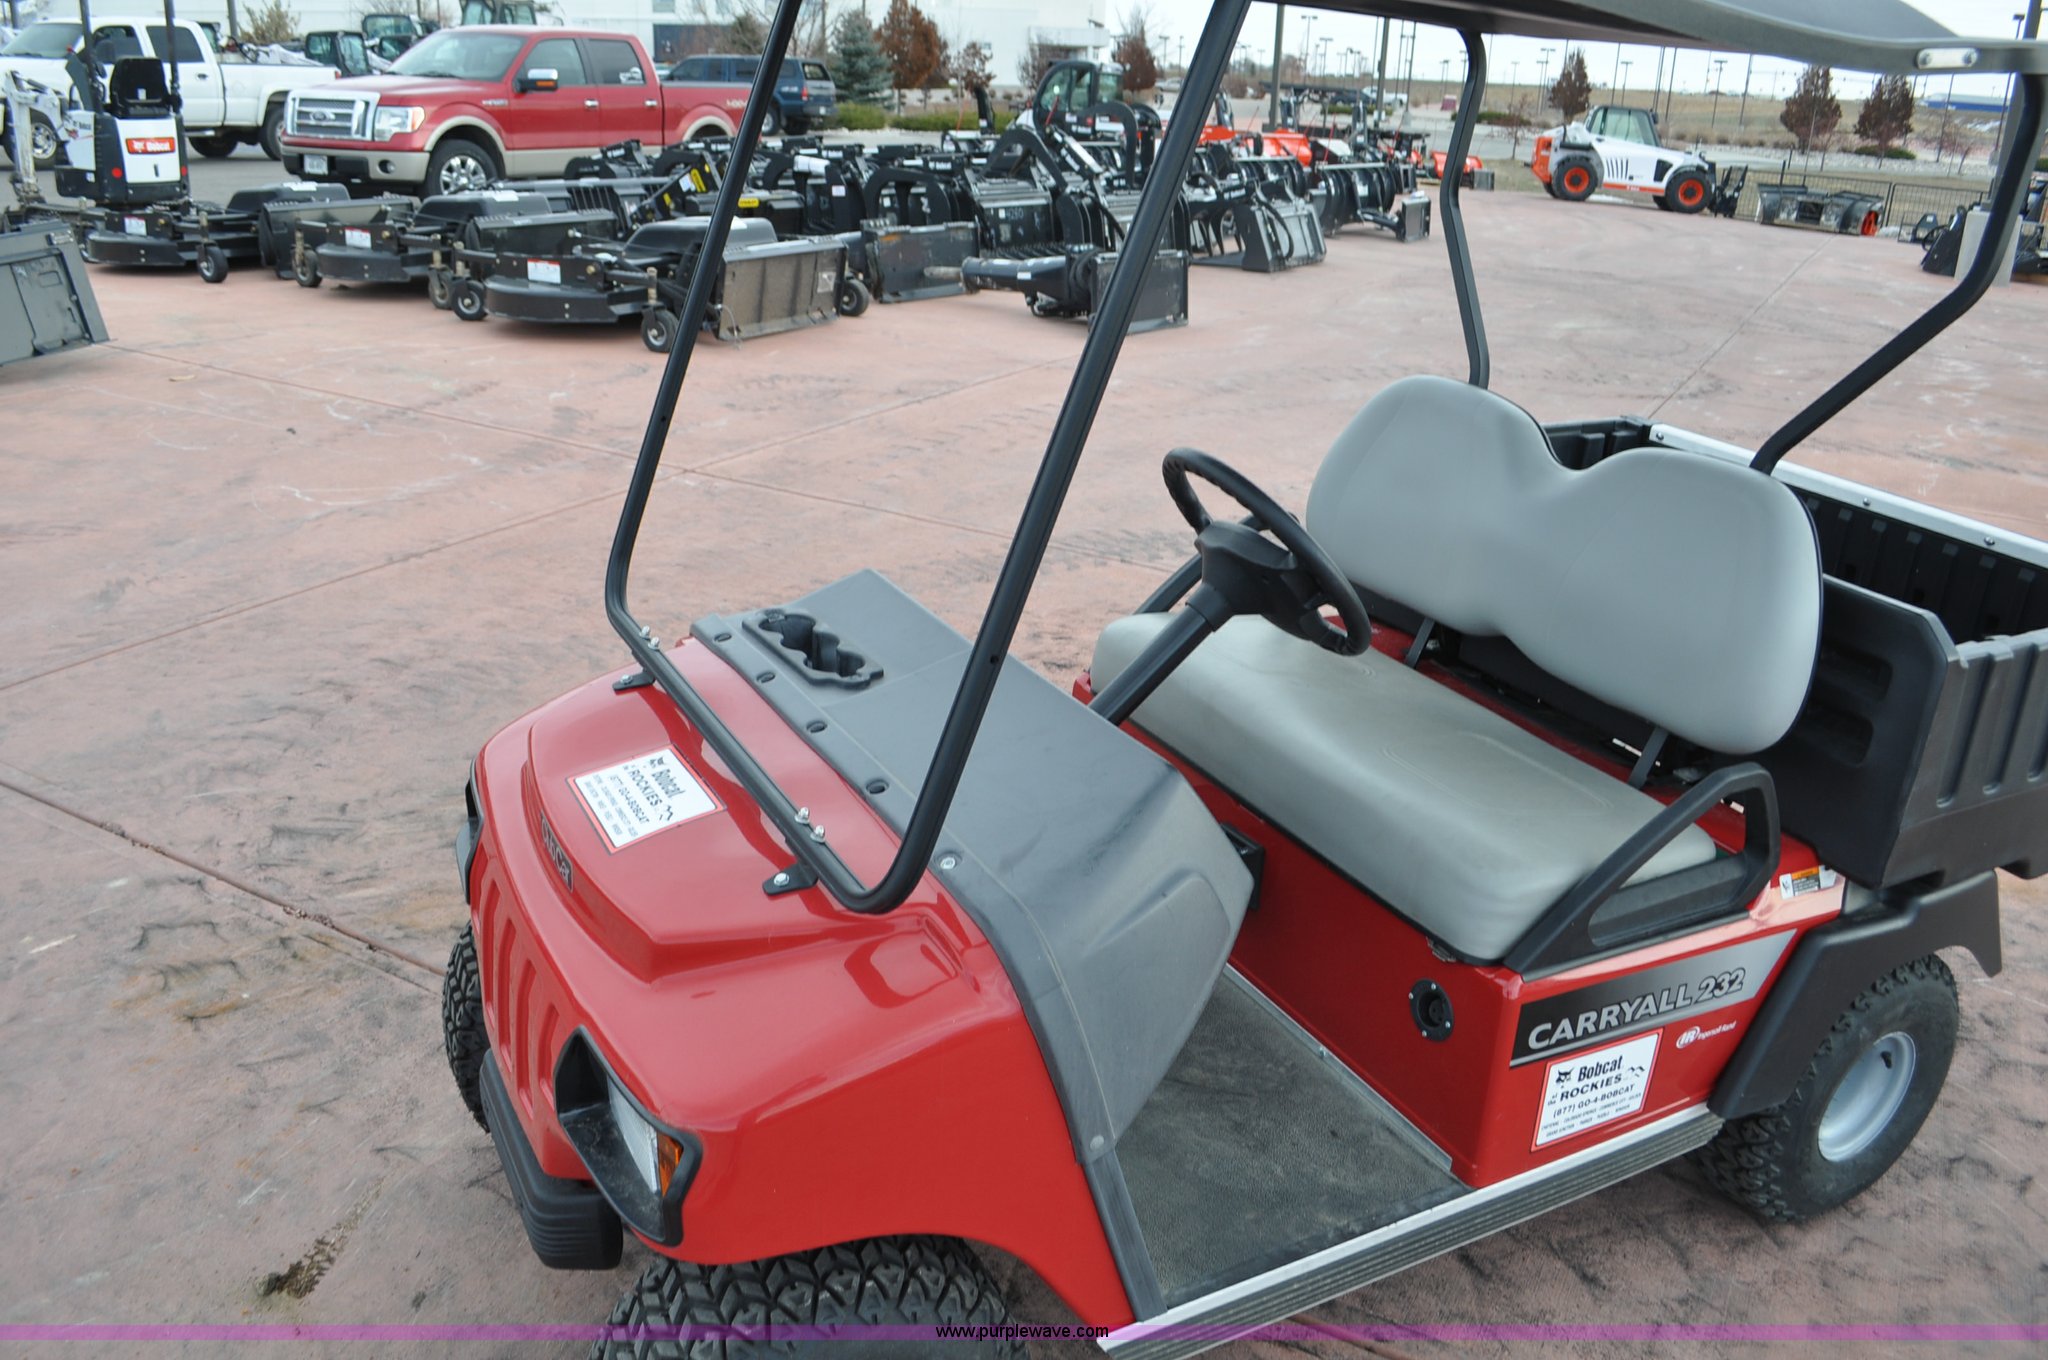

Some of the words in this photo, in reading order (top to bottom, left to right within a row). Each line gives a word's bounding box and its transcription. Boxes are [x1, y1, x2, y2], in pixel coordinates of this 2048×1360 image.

[628, 768, 663, 807] ROCKIES
[651, 768, 686, 799] Bobcat
[1528, 984, 1692, 1050] CARRYALL
[1694, 967, 1746, 1004] 232
[1577, 1055, 1623, 1082] Bobcat
[1553, 1103, 1576, 1118] (877)
[1578, 1083, 1635, 1109] GO-4-BOBCAT
[1560, 1073, 1623, 1102] ROCKIES
